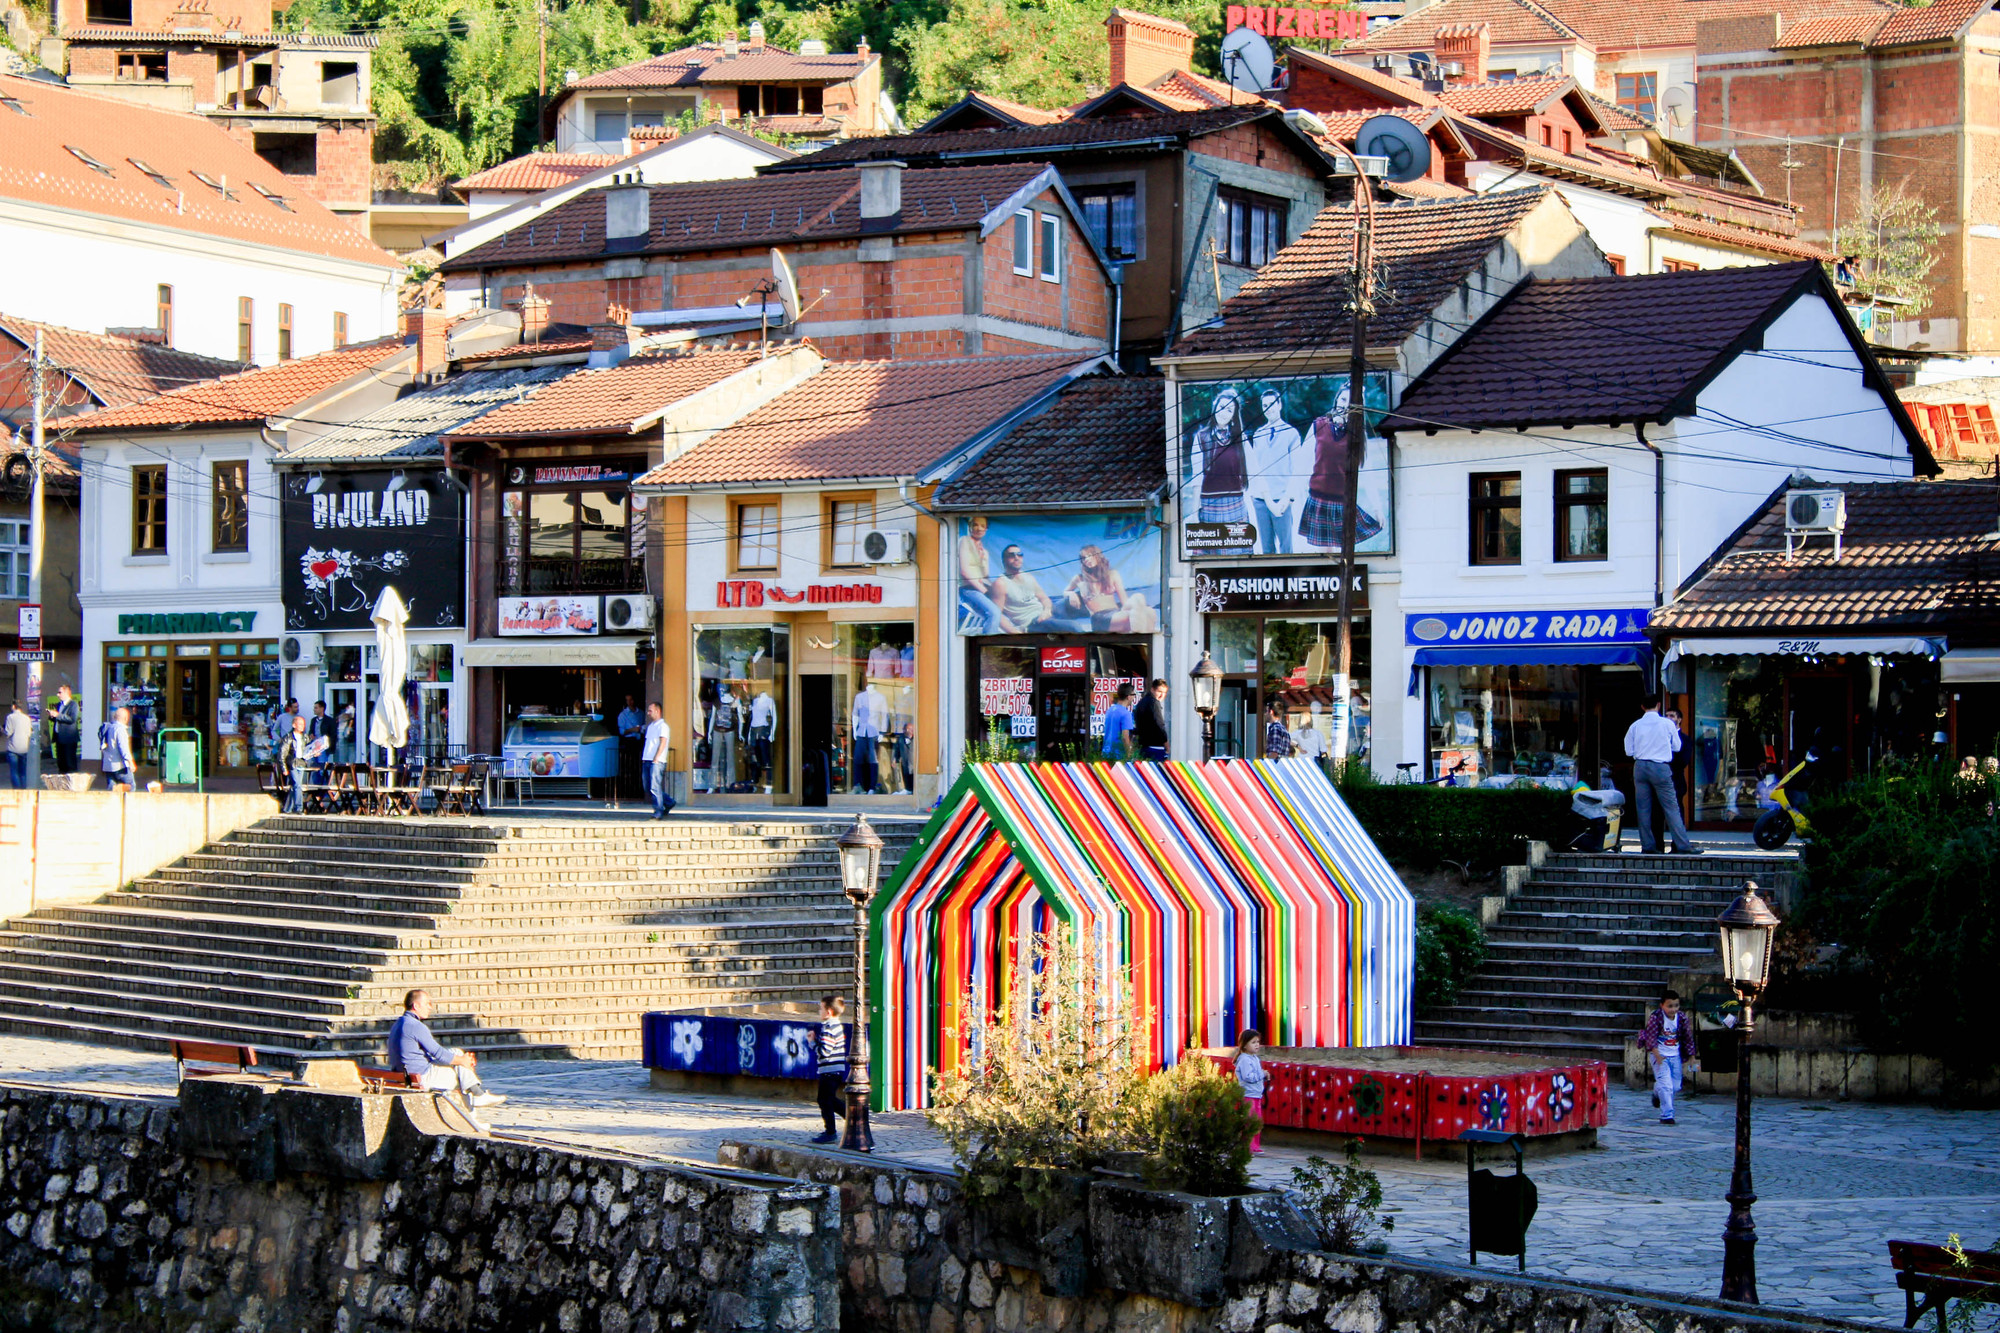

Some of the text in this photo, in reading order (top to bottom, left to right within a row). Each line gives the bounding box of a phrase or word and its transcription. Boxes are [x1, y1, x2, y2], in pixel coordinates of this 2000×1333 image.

[1226, 5, 1369, 40] PRIZRENI
[312, 489, 430, 530] BIJULAND
[1187, 529, 1216, 538] Prodhues
[1187, 537, 1253, 547] uniformave shkollore
[1219, 576, 1363, 593] FASHION NETWOK
[717, 581, 764, 608] LTB
[1248, 592, 1335, 601] INDUSTRIES
[118, 611, 257, 635] PHARMACY
[1450, 614, 1618, 640] JONOZ RADA
[1778, 641, 1820, 653] R&M
[19, 653, 45, 661] KALAJA
[1042, 659, 1083, 668] CONS
[984, 679, 1033, 692] ZBRITJE
[984, 694, 998, 715] 20
[1008, 694, 1032, 716] 50%
[1095, 694, 1109, 715] 20
[1014, 726, 1027, 735] 10
